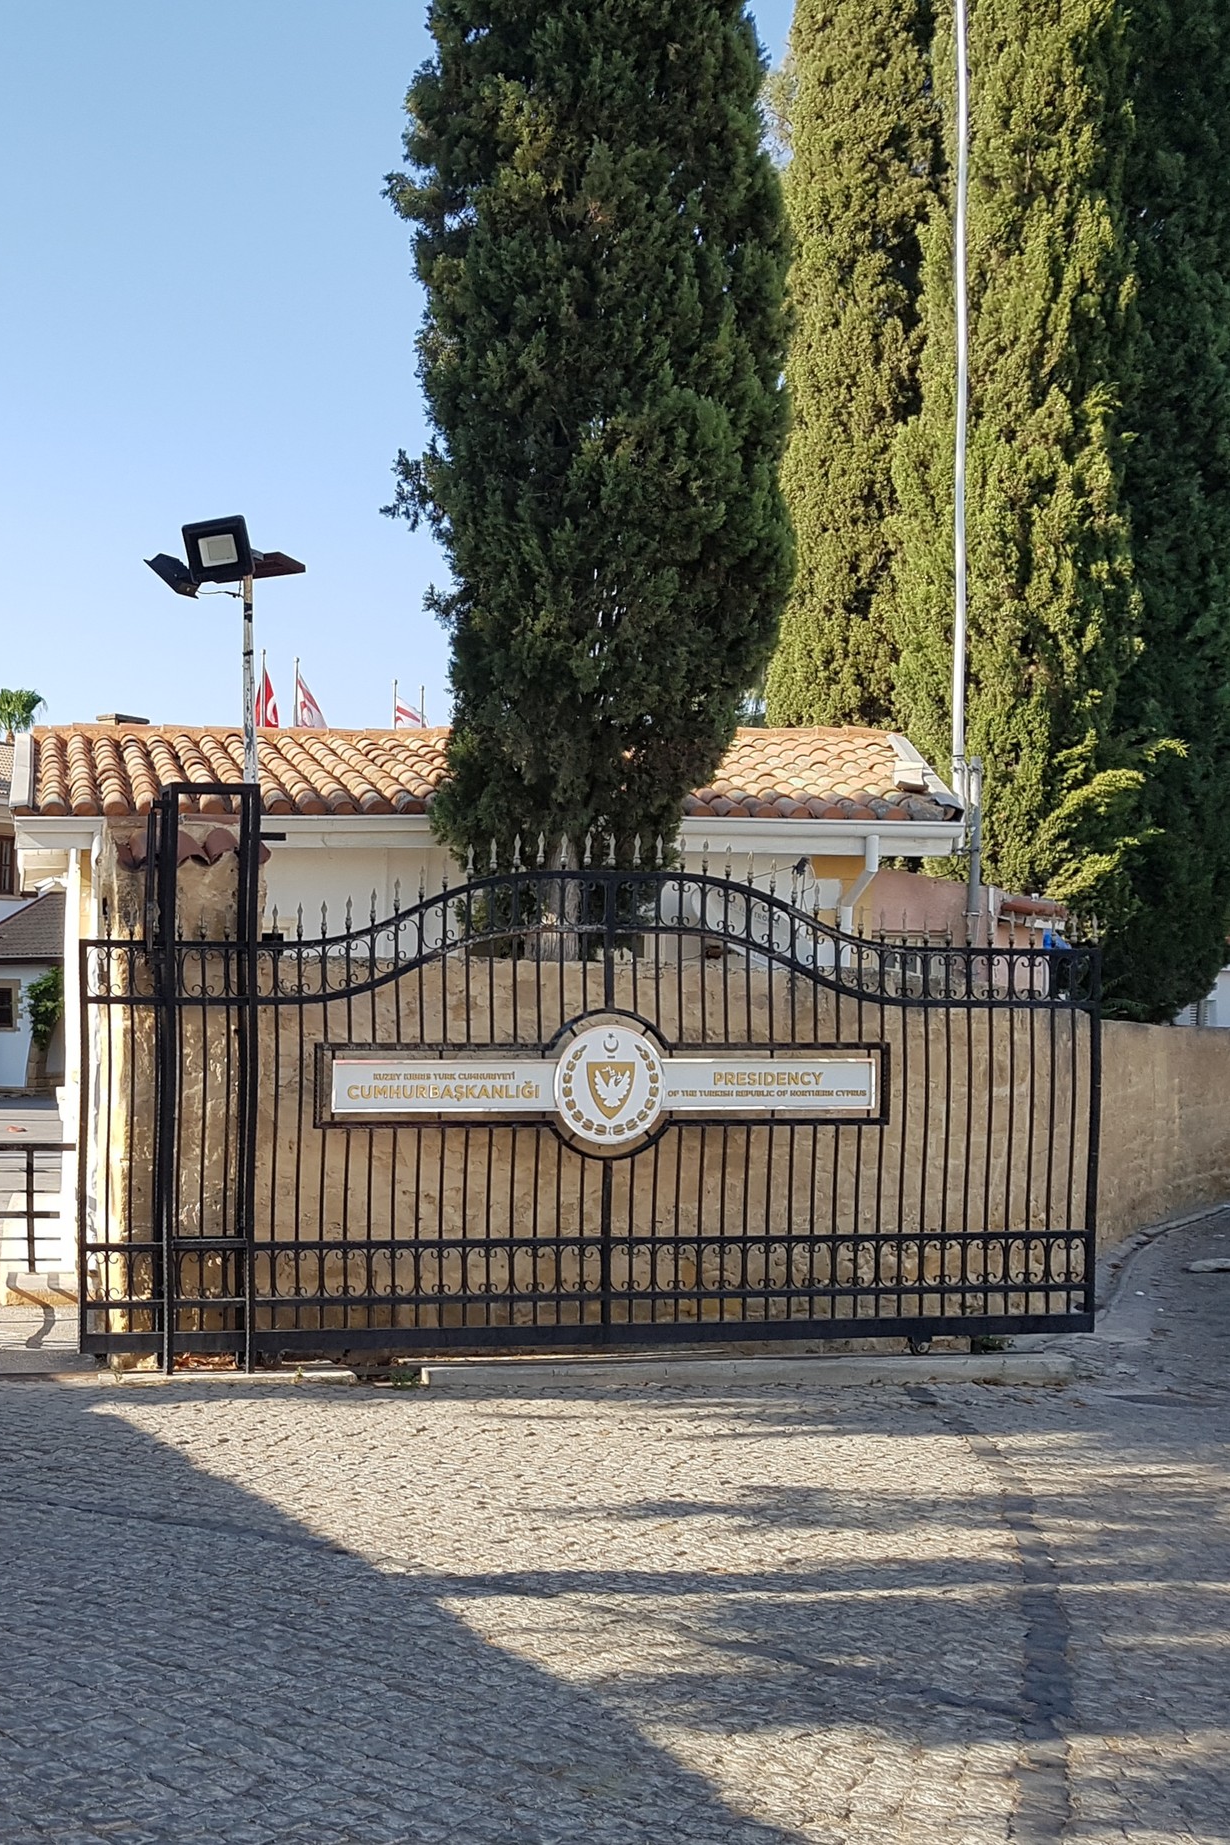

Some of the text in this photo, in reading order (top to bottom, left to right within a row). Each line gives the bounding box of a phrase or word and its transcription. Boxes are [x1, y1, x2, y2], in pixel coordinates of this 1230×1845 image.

[373, 1072, 402, 1081] KUZEY
[713, 1071, 824, 1086] PRESIDENCY
[347, 1081, 540, 1102] CUMHURBAŞKANLIĞI
[667, 1089, 867, 1098] OF THE TURKISH REPUBLIC OF NORTHERN CYPRUS
